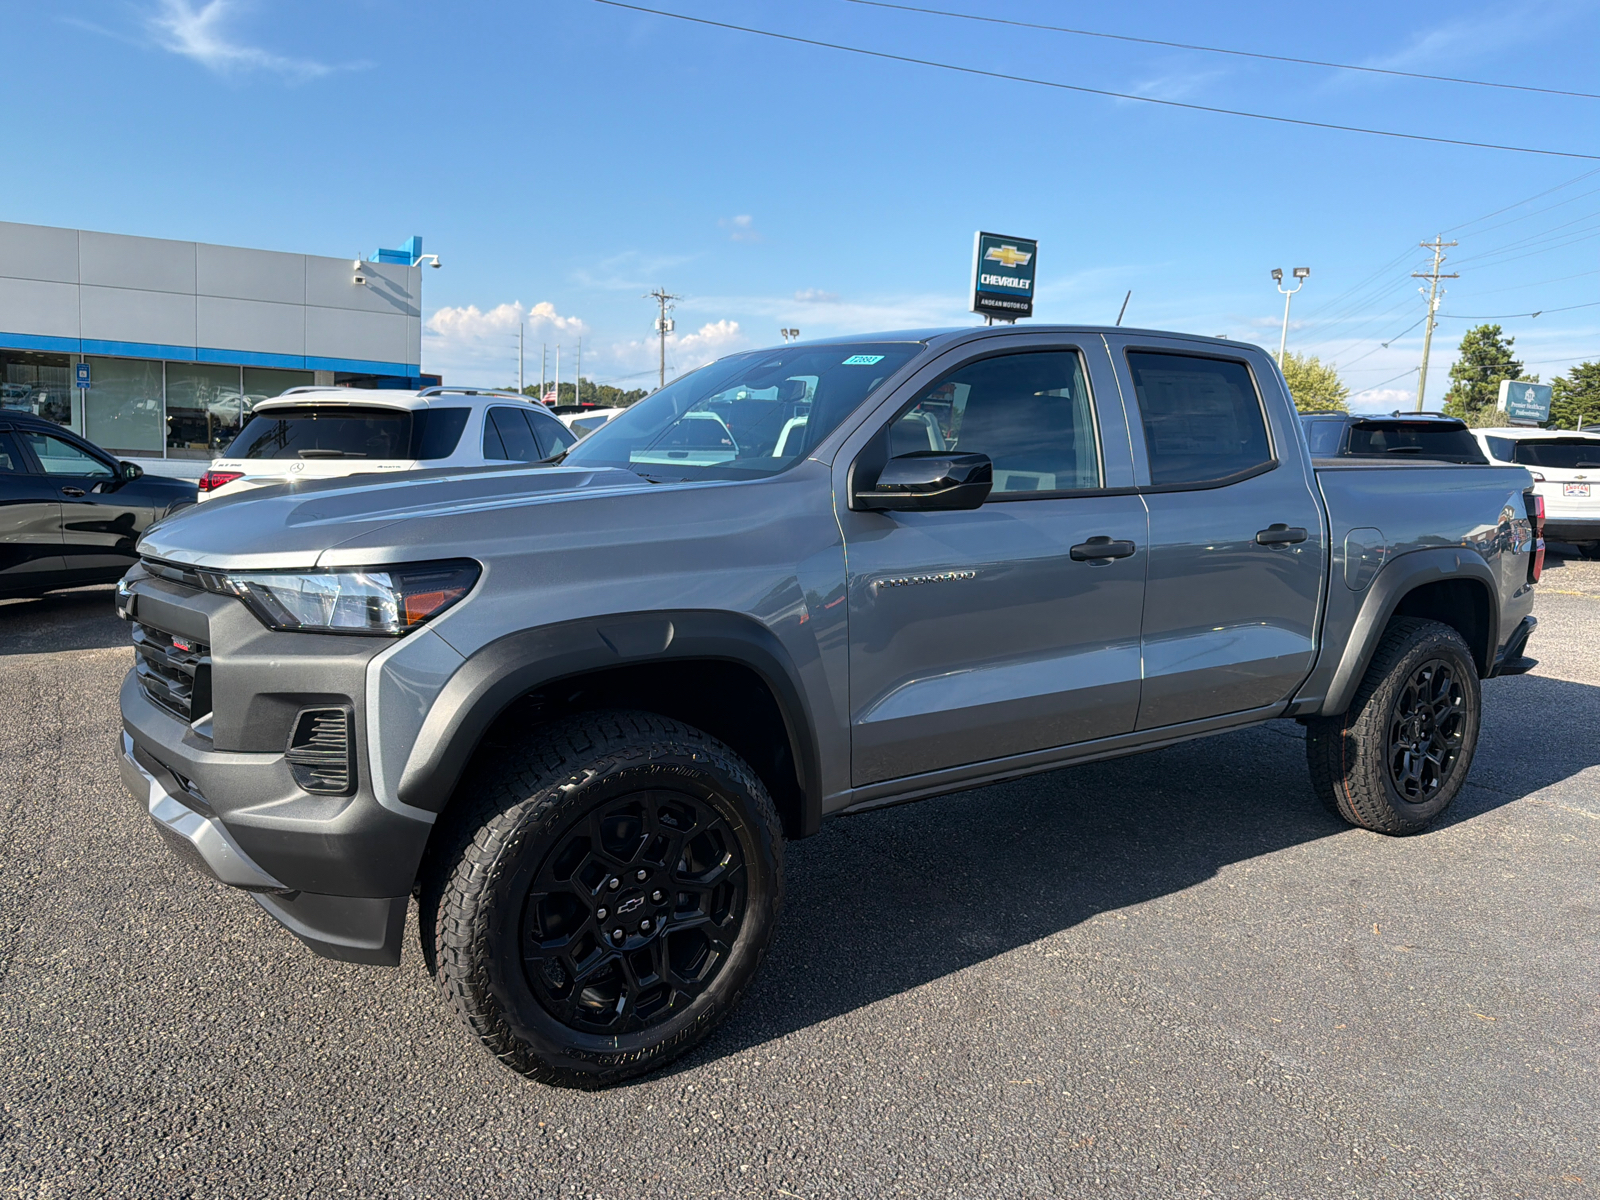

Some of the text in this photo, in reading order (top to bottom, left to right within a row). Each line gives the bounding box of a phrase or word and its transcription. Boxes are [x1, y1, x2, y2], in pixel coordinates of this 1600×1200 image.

[981, 273, 1031, 289] CHEVROLET
[981, 299, 1002, 307] ANDEAN
[1003, 301, 1020, 309] MOTOR
[878, 571, 976, 588] COLORADO
